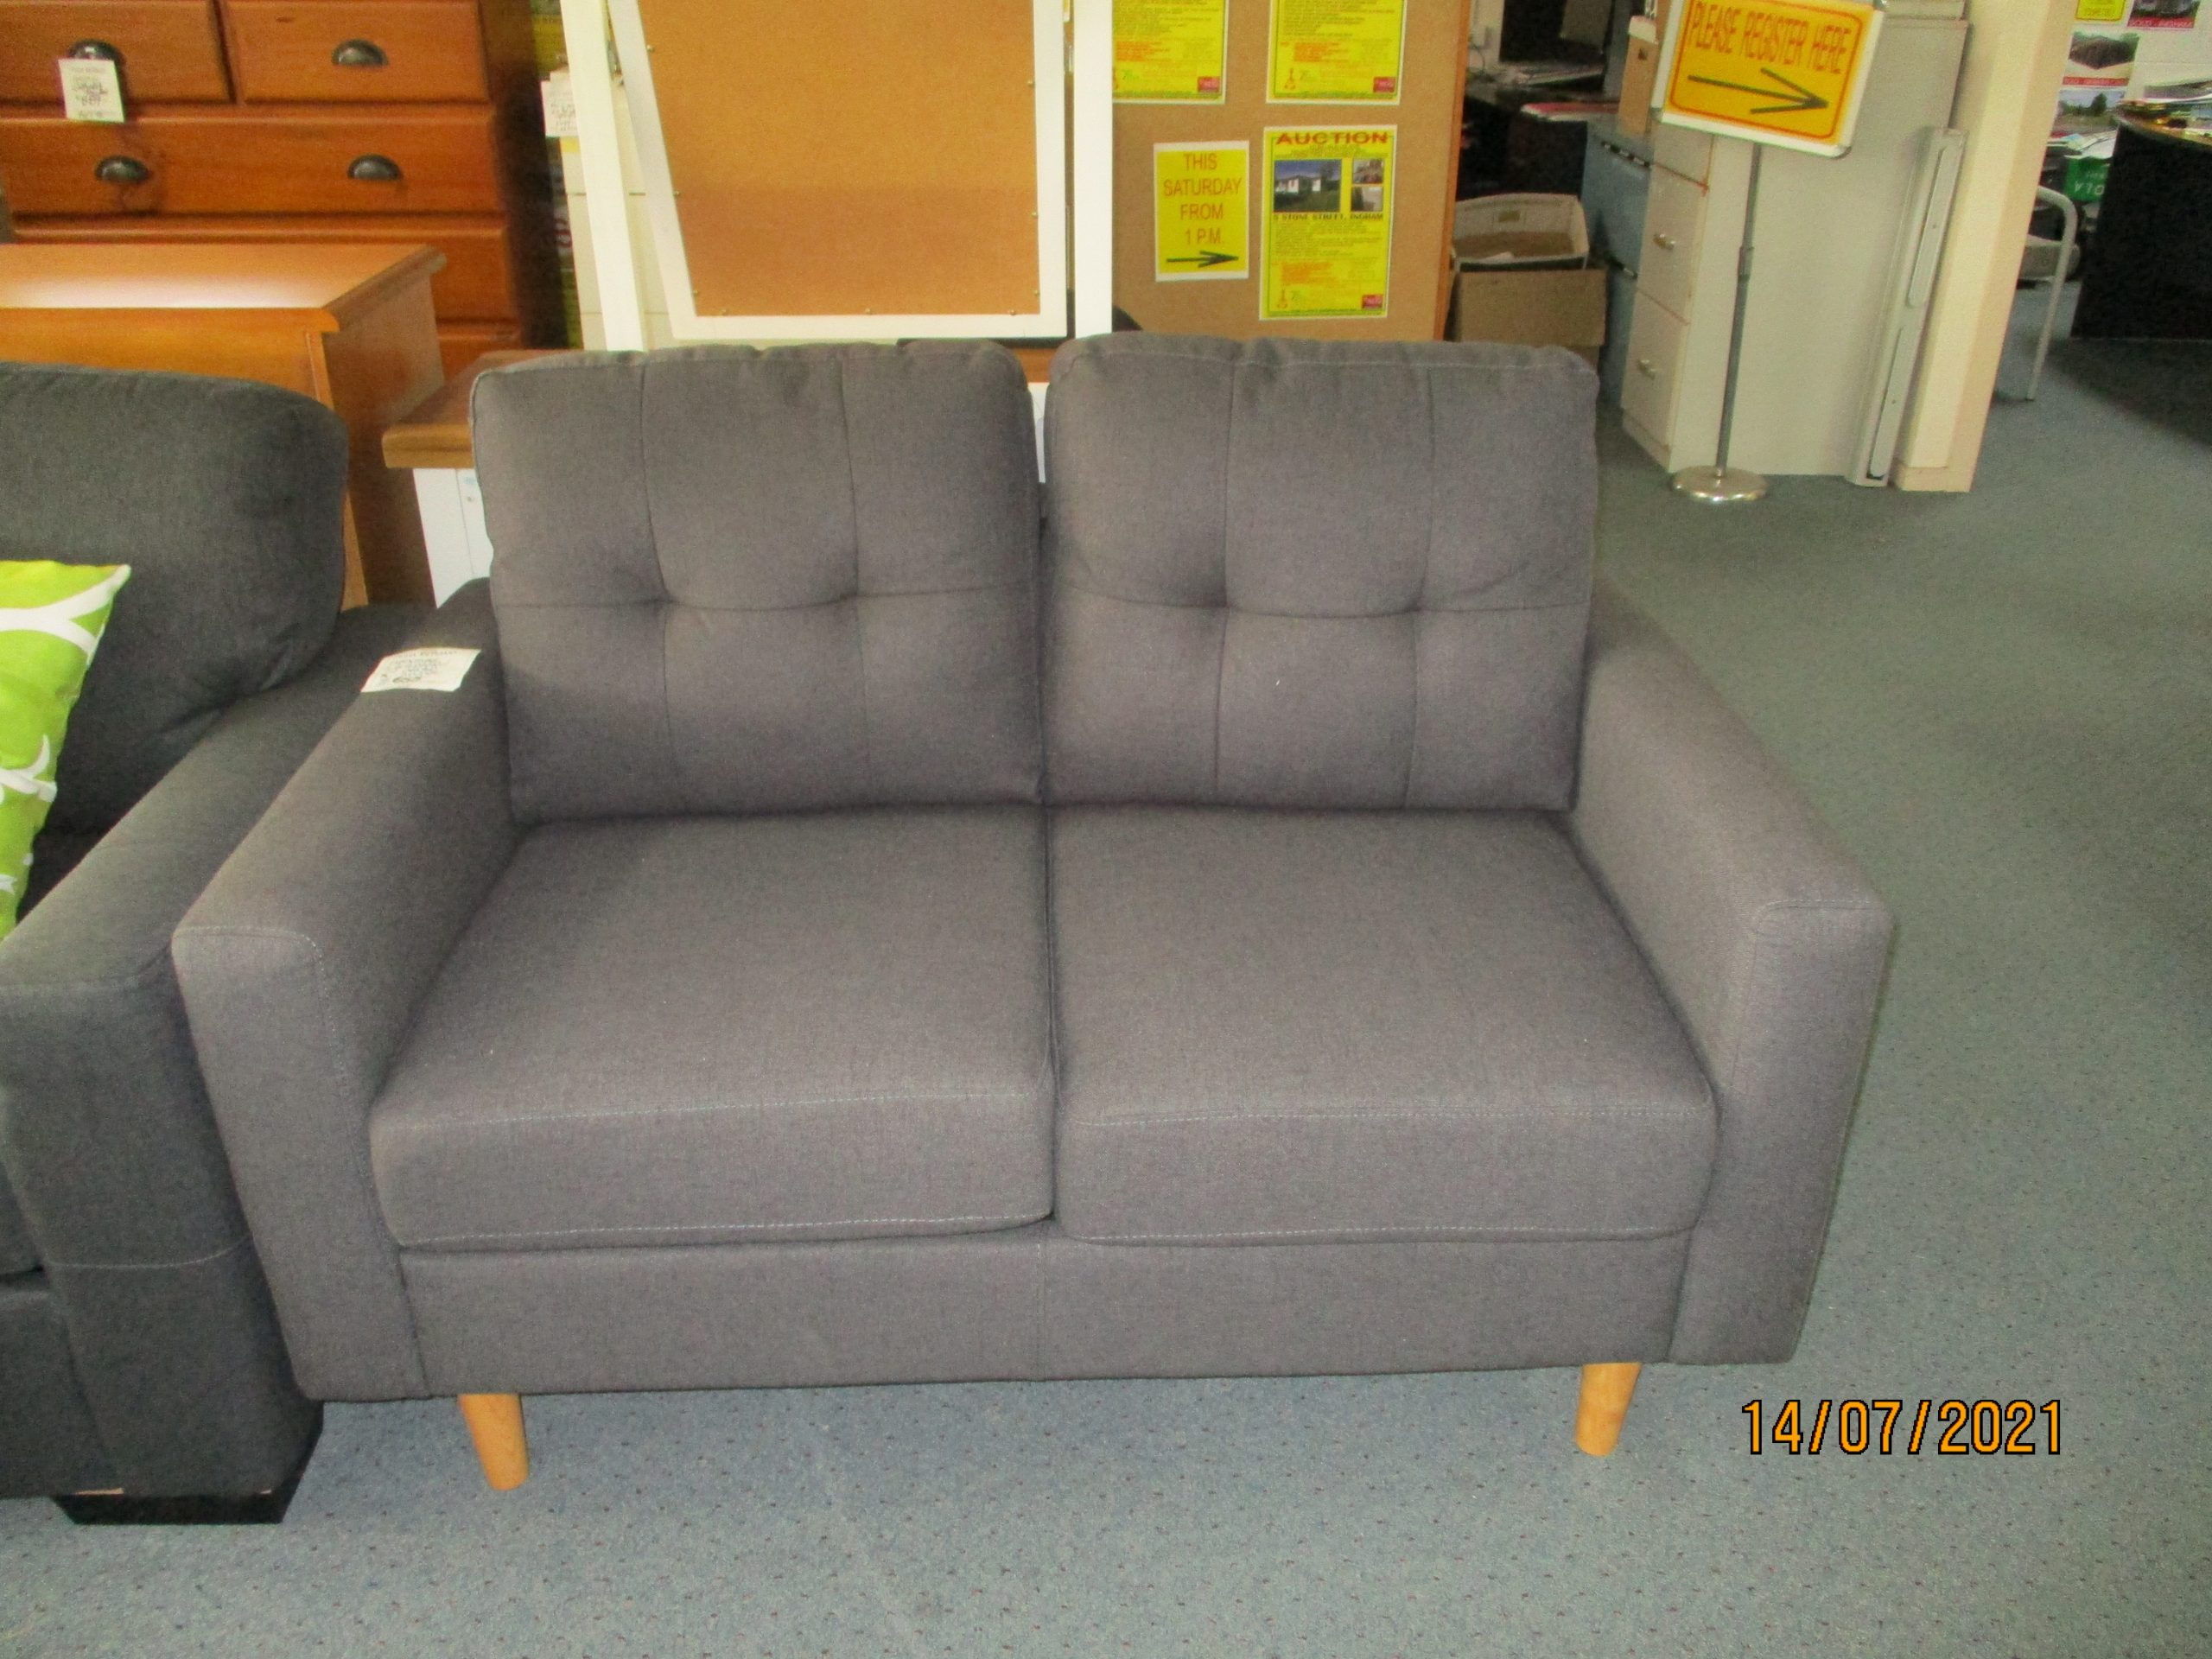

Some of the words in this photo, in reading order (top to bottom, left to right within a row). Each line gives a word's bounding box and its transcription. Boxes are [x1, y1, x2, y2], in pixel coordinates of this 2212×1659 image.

[1688, 2, 1742, 54] PLEASE
[1739, 11, 1809, 67] REGISTER
[1808, 24, 1852, 73] HERE
[1276, 131, 1389, 145] AUCTION
[1183, 153, 1217, 170] THIS
[1163, 178, 1243, 196] SATURDAY
[1180, 203, 1224, 220] FROM
[1185, 228, 1192, 245] 1
